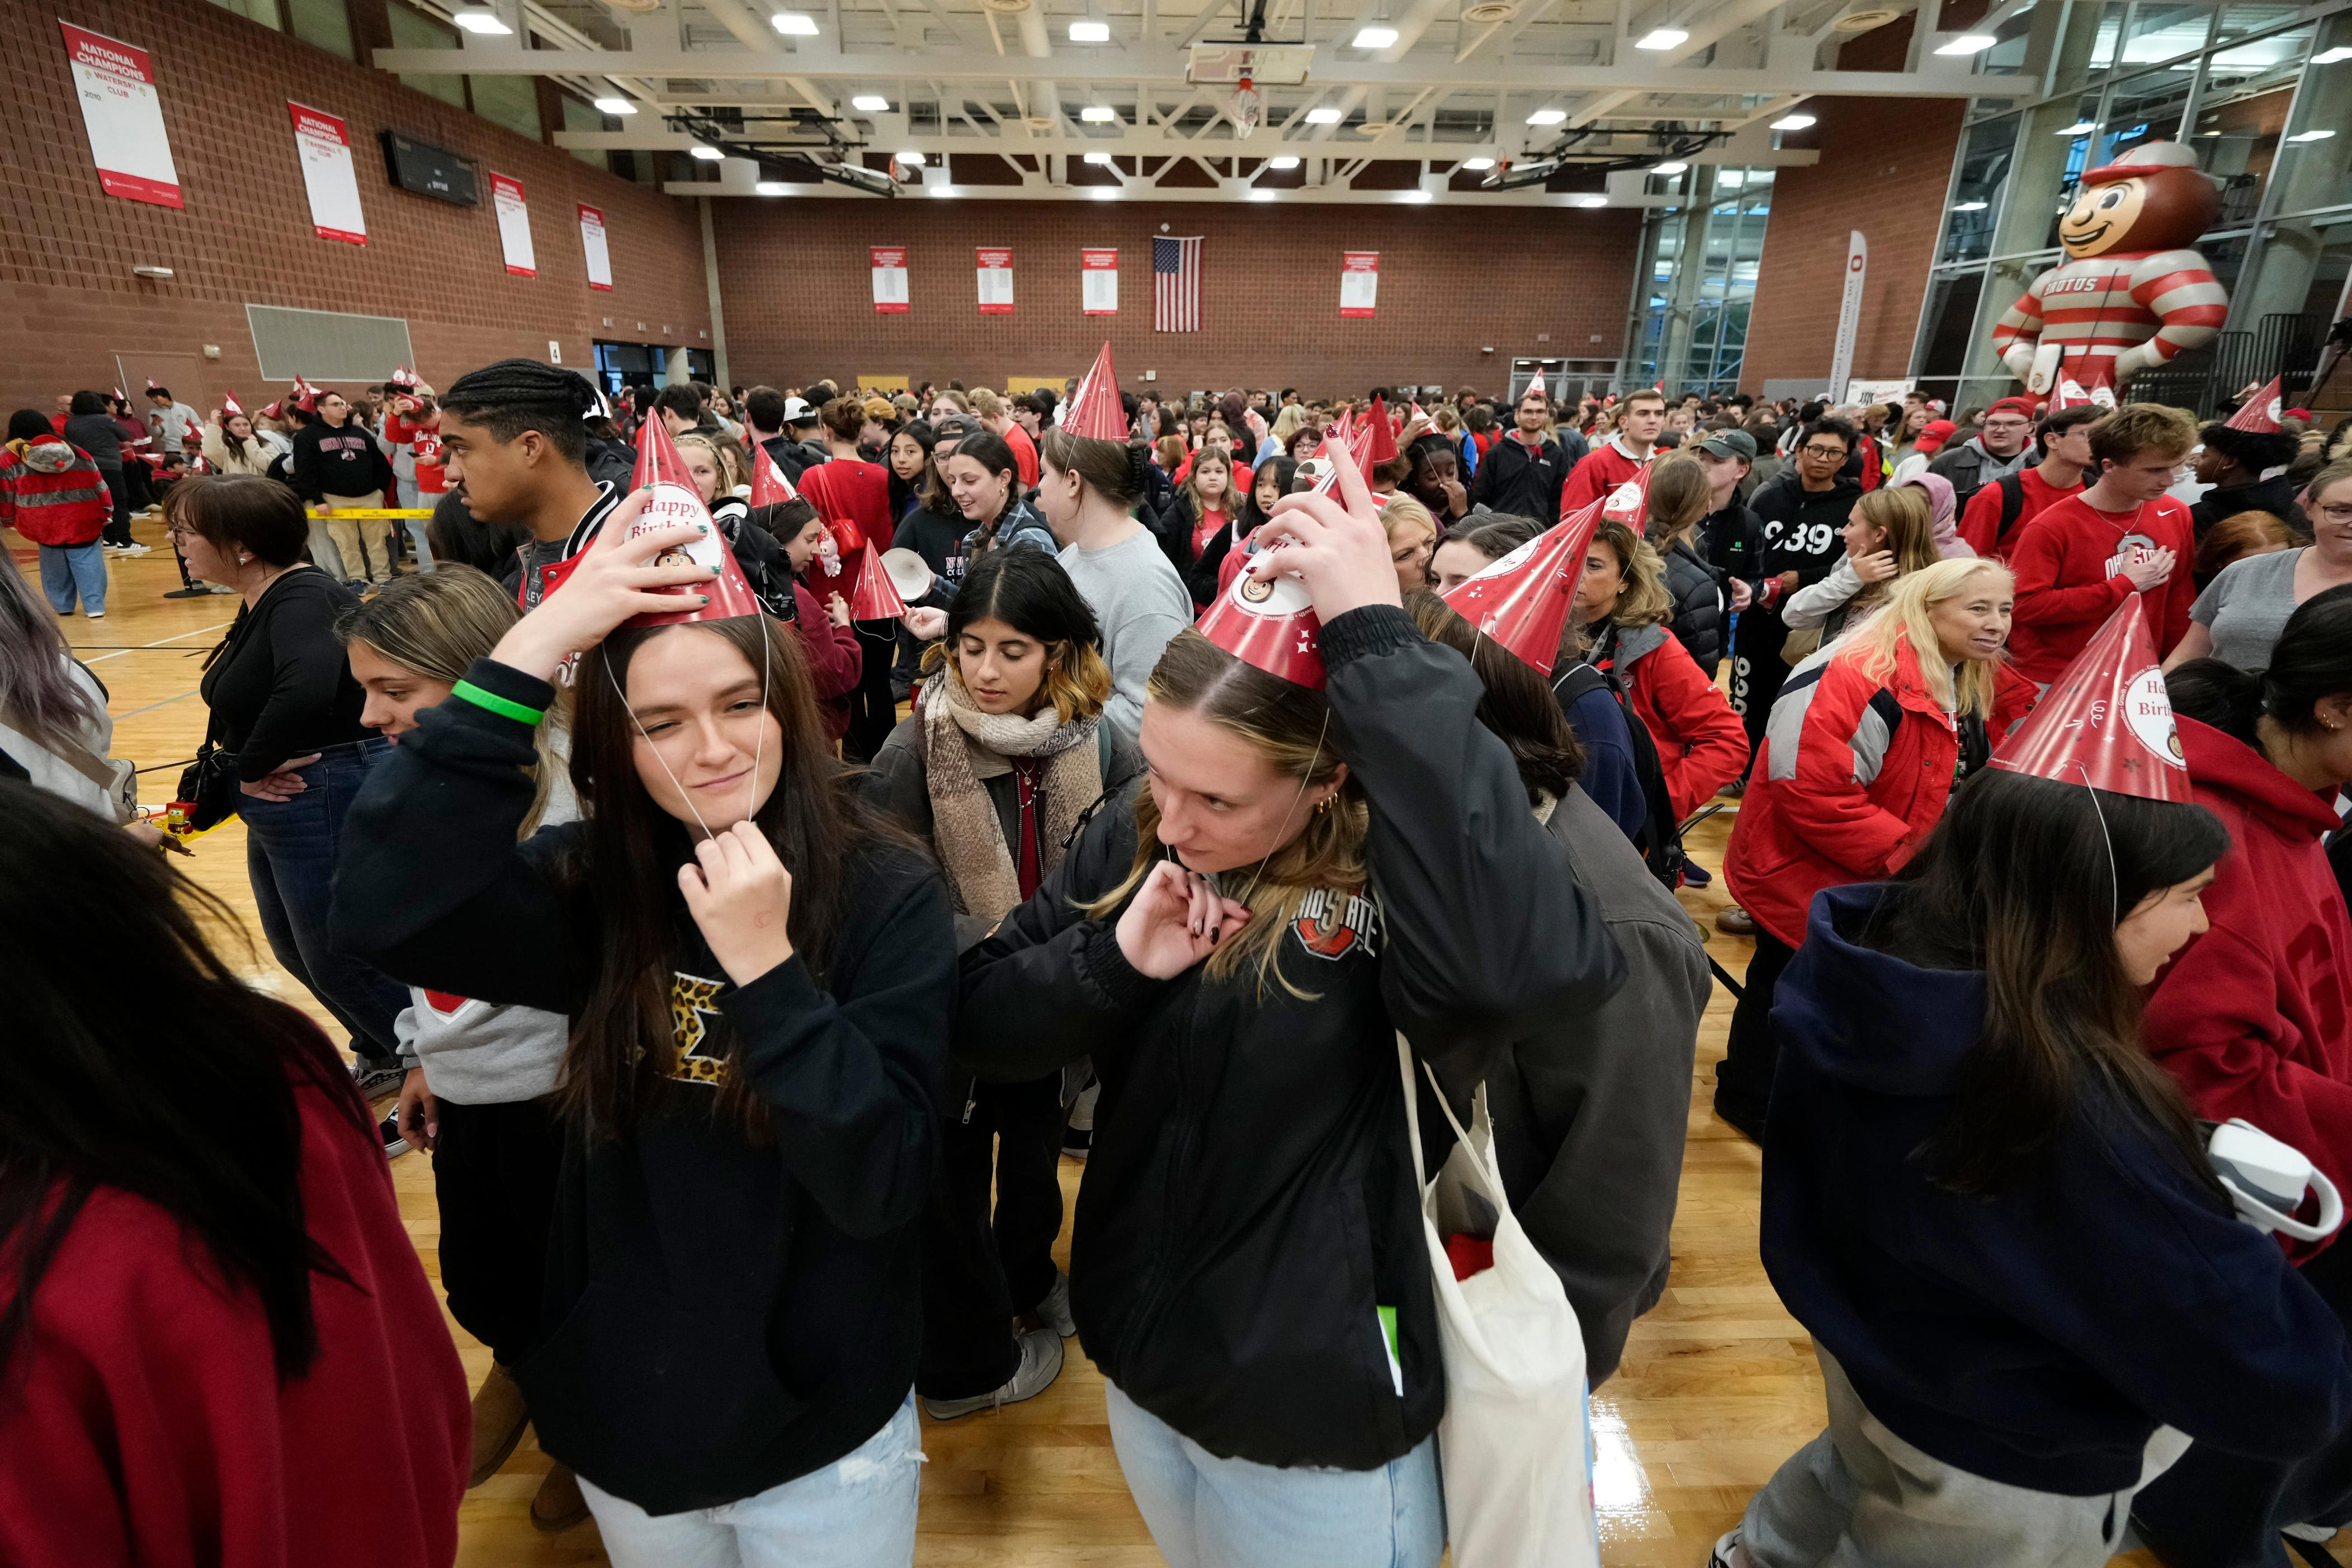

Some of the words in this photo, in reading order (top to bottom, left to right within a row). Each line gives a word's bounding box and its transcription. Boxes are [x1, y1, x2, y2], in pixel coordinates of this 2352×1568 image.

[80, 41, 137, 68] NATIONAL
[77, 51, 146, 82] CHAMPIONS
[94, 71, 136, 90] WATERSKI
[83, 91, 102, 101] 2010
[107, 86, 130, 98] CLUB
[298, 124, 342, 144] CHAMPIONS
[300, 115, 338, 135] NATIONAL
[552, 349, 558, 360] 4
[640, 499, 699, 518] Happy
[2118, 688, 2127, 706] Growth
